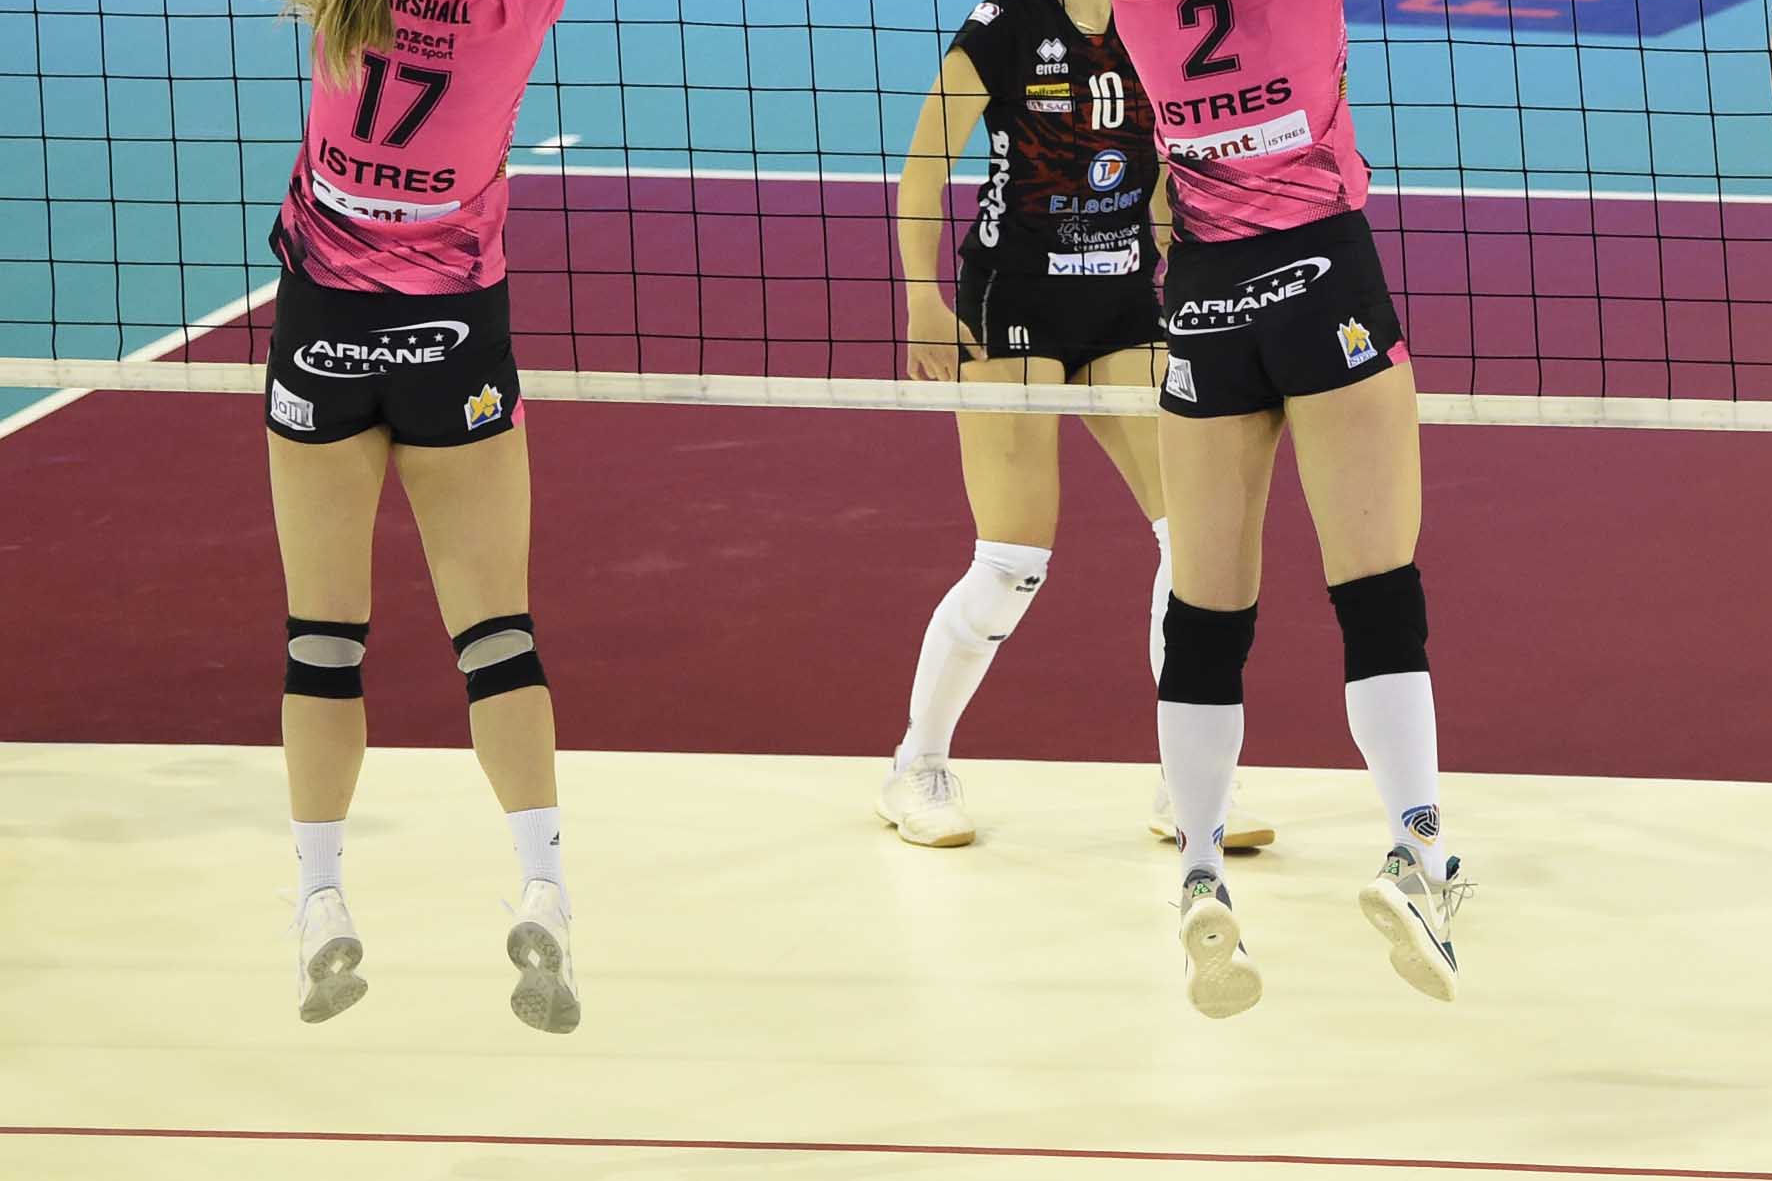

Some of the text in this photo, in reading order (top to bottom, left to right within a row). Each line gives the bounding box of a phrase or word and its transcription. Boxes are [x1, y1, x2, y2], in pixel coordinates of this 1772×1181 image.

[350, 51, 453, 149] 17
[1088, 71, 1125, 131] 10
[1158, 77, 1292, 126] ISTRES
[1268, 127, 1306, 147] ISTRES
[318, 136, 456, 193] ISTRES
[1178, 279, 1308, 317] ARIANE
[1176, 313, 1253, 328] HOTEL
[306, 355, 387, 373] HOTEL
[309, 339, 446, 364] ARIANE
